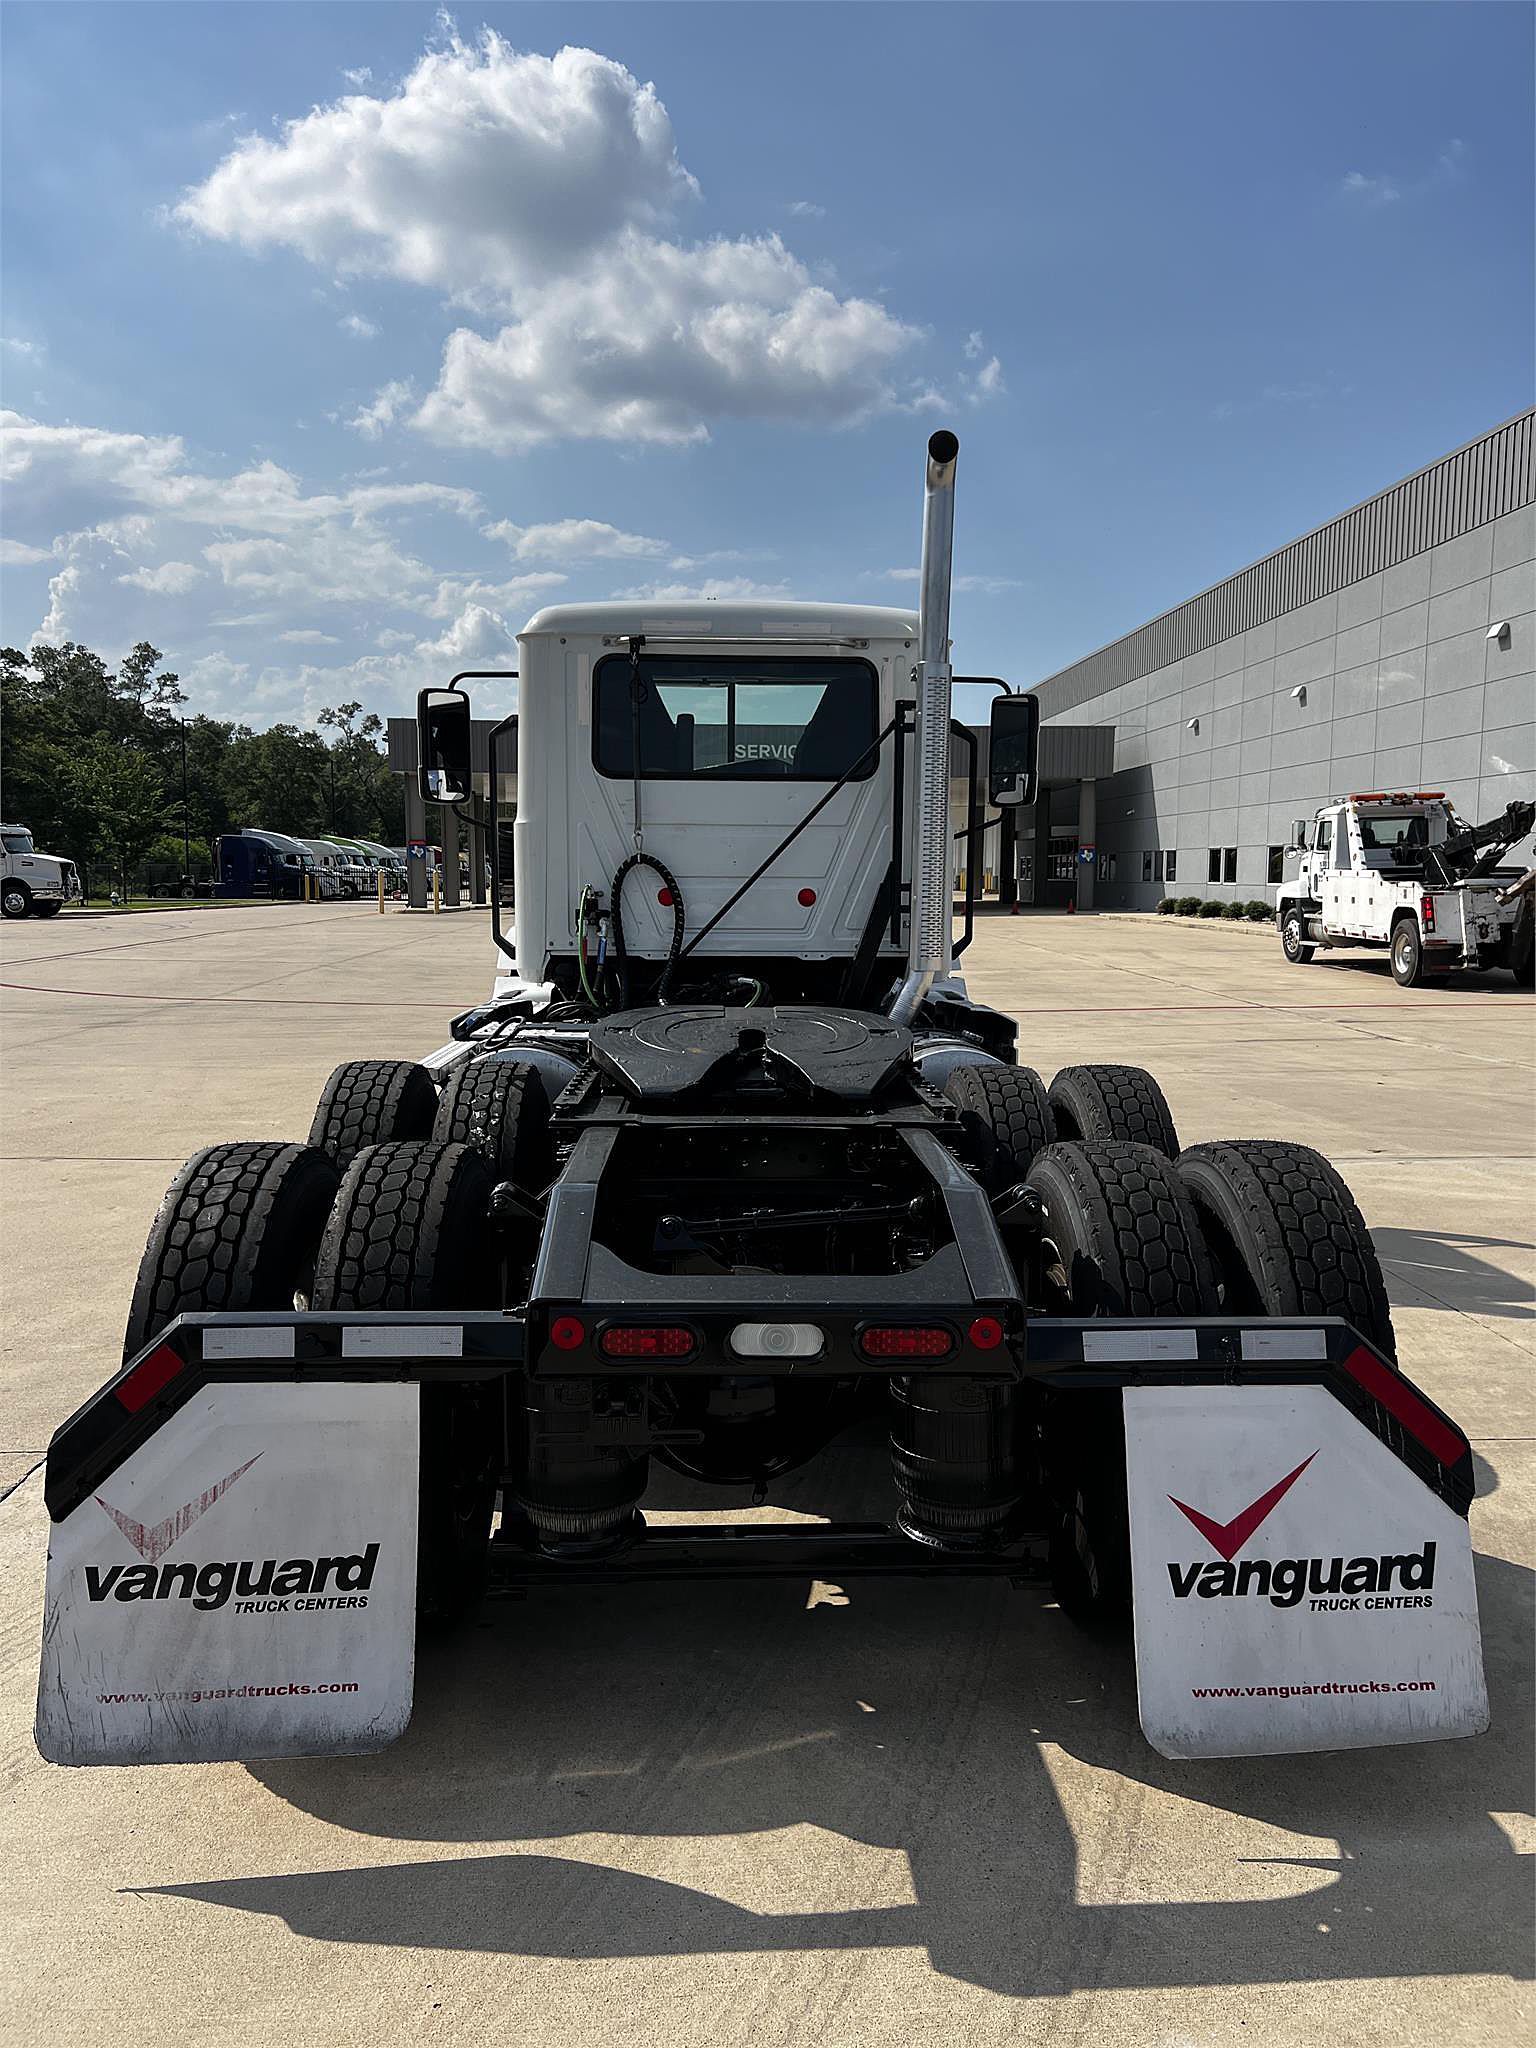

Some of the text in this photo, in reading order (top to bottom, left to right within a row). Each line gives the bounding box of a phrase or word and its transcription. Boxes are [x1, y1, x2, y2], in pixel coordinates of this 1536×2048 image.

[85, 1542, 381, 1611] vanguard
[1167, 1541, 1437, 1608] vanguard
[234, 1596, 368, 1614] TRUCK CENTERS
[1309, 1596, 1433, 1612] TRUCK CENTERS
[1192, 1680, 1437, 1699] www.vanguardtrucks.com
